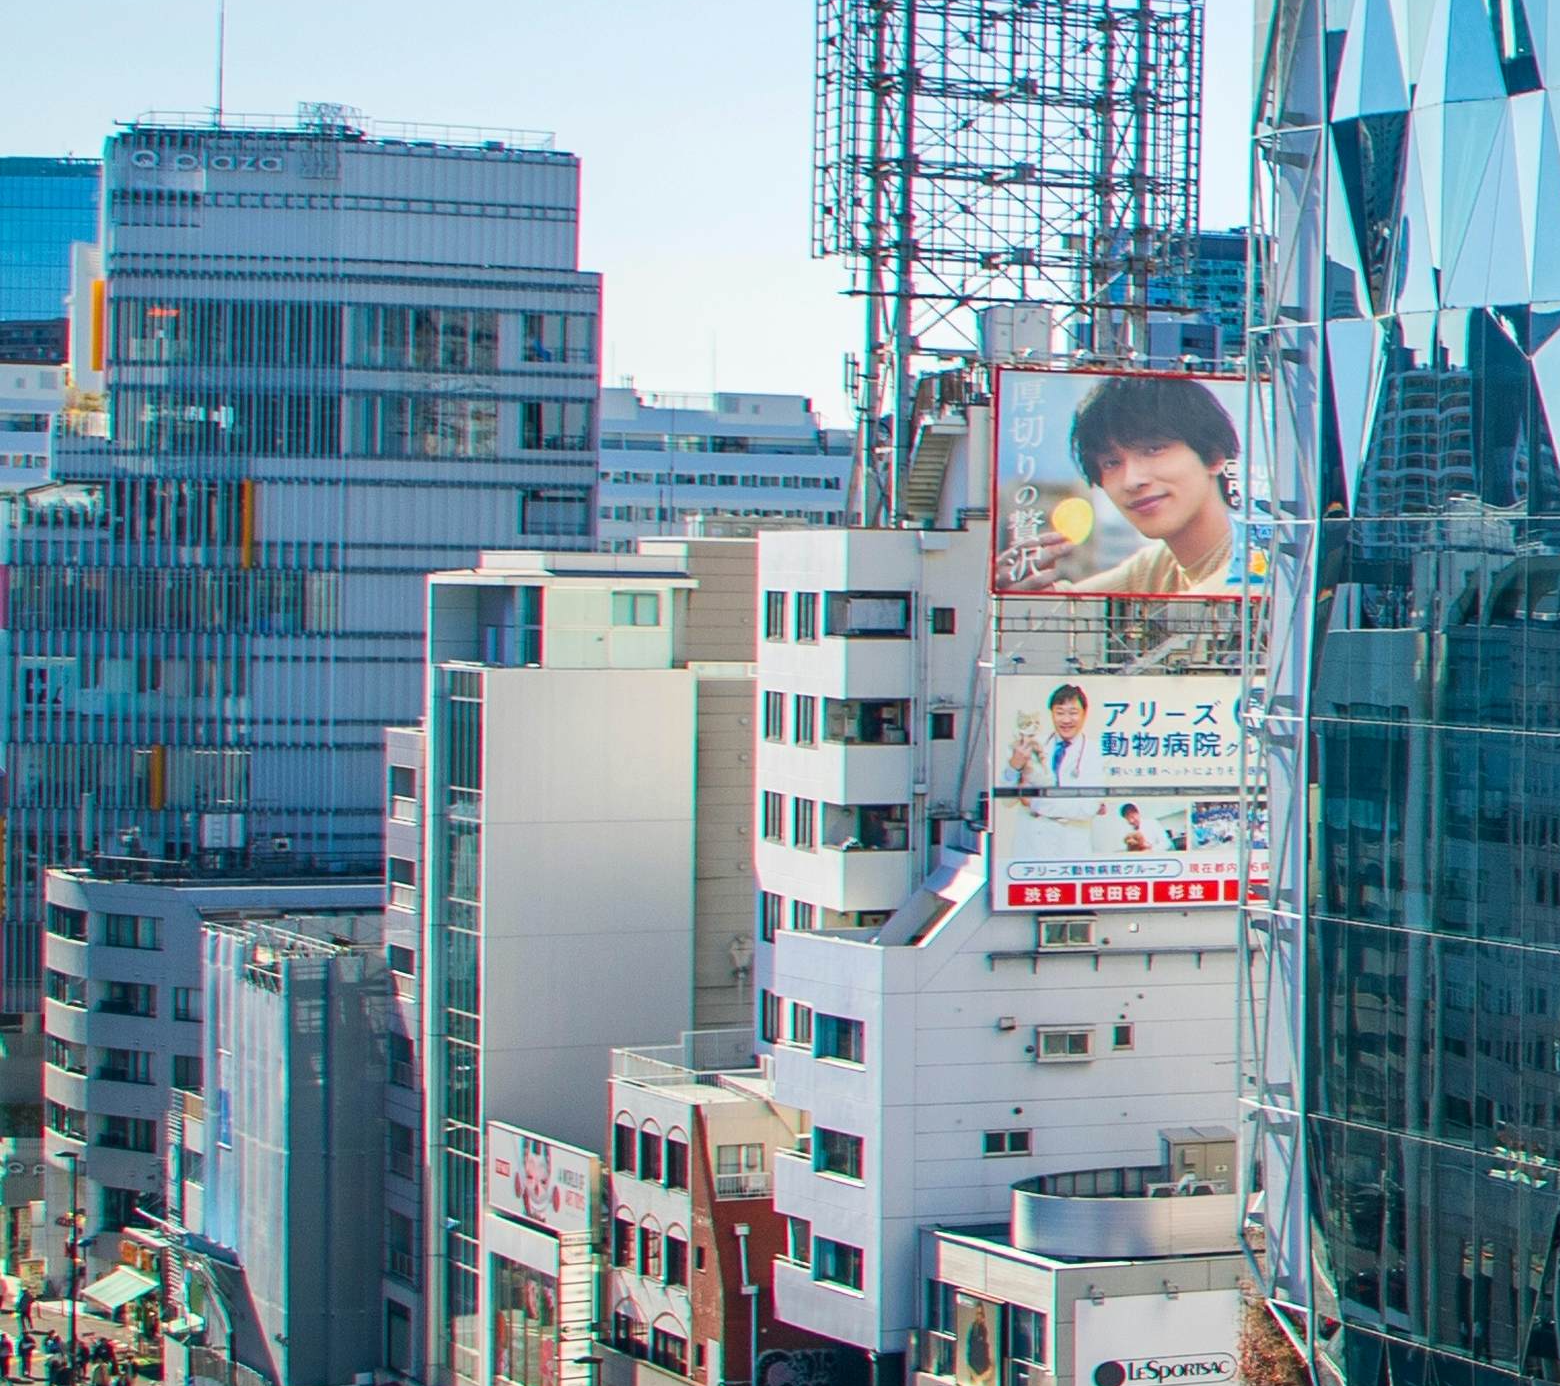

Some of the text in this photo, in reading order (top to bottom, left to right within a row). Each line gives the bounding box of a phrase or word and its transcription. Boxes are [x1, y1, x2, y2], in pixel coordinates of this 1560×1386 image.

[1103, 700, 1222, 727] アリーズ
[1024, 884, 1205, 903] 渋谷 世田谷 杉並
